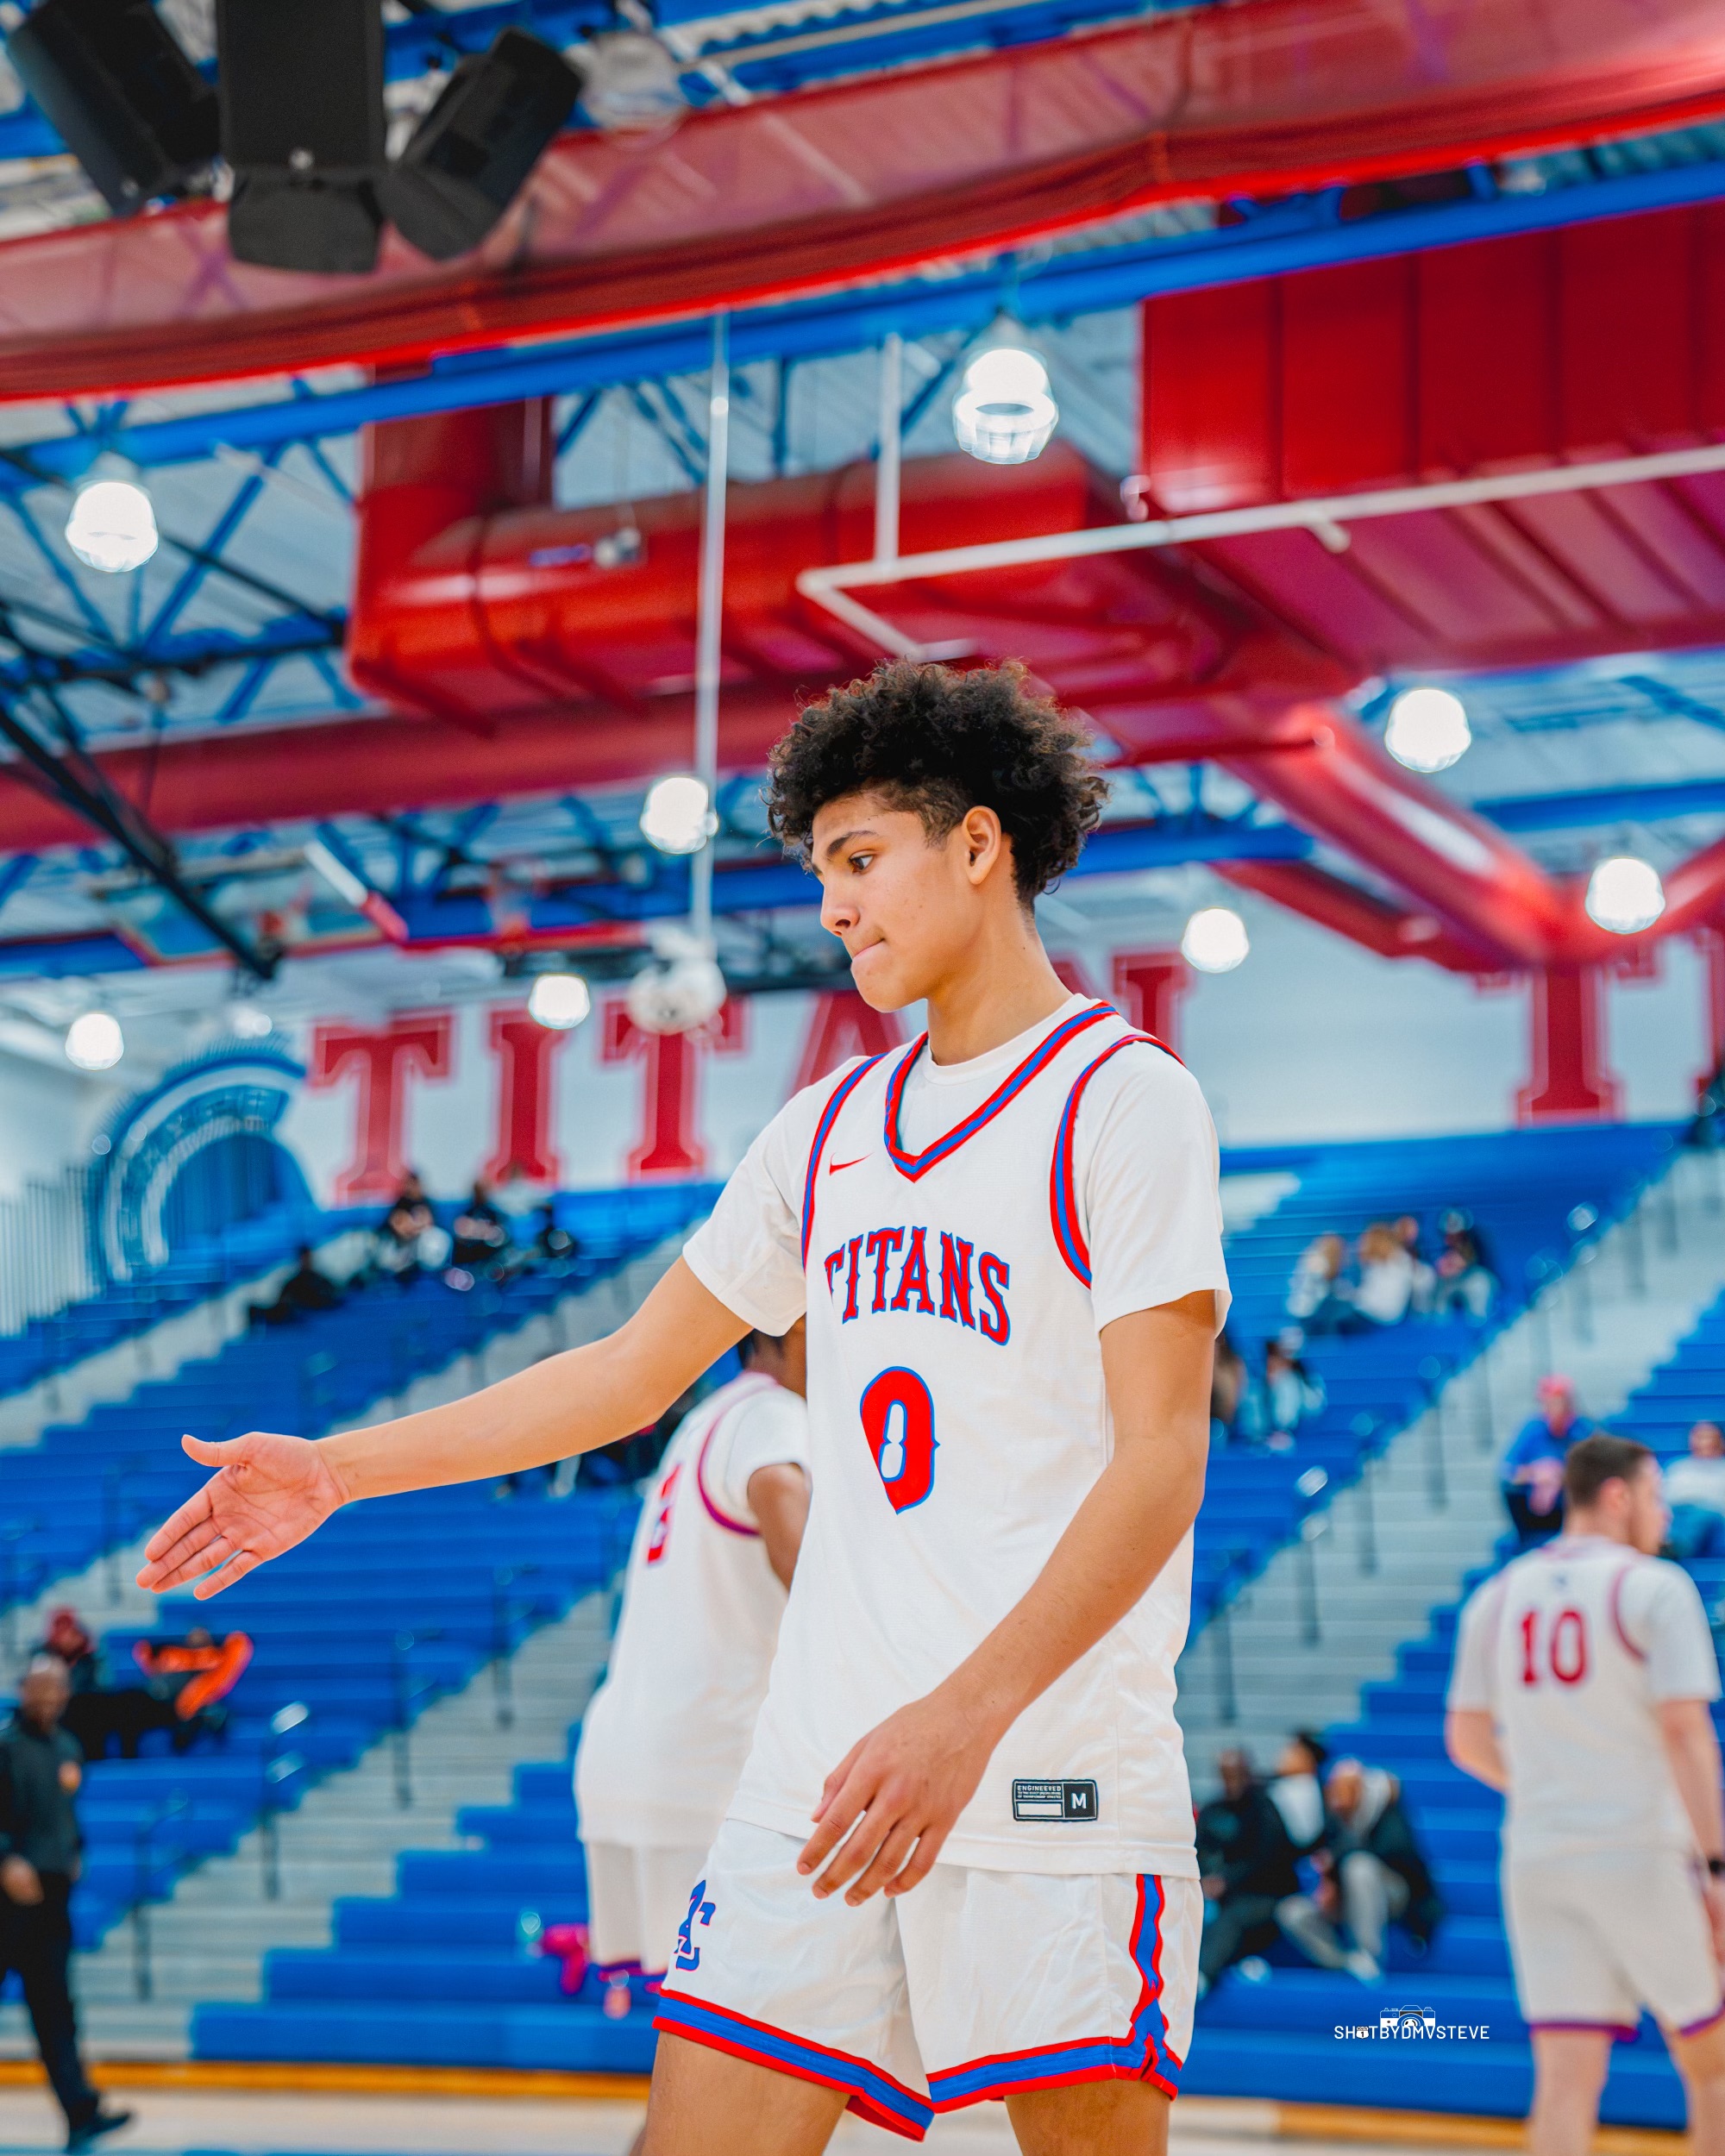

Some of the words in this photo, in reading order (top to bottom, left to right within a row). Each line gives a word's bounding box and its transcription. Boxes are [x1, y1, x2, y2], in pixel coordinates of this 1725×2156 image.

[859, 1365, 941, 1515] 0
[1520, 1610, 1587, 1685] 10
[1071, 1792, 1087, 1809] M
